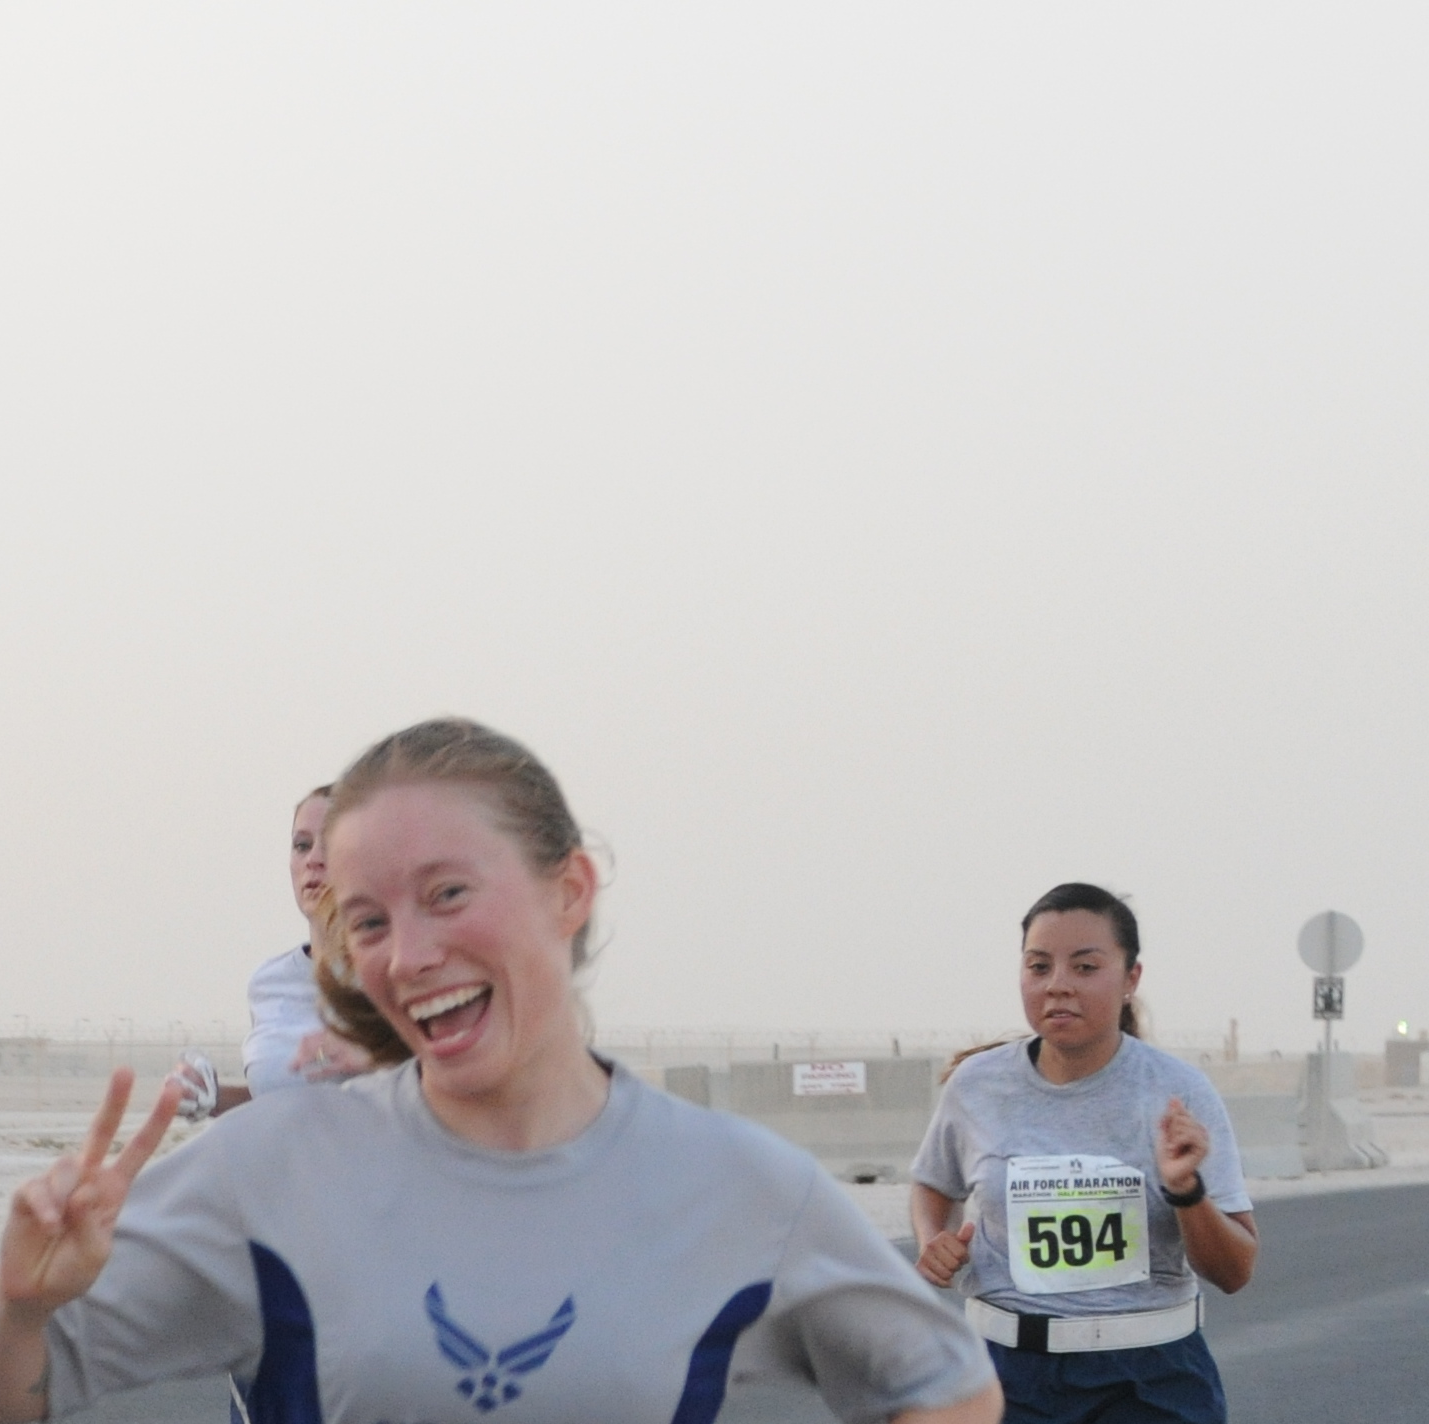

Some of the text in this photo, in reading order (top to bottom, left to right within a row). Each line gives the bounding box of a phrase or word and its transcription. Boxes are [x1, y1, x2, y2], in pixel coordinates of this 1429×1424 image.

[1010, 1176, 1141, 1191] AIR FORCE MARATHON
[1027, 1212, 1128, 1269] 594
